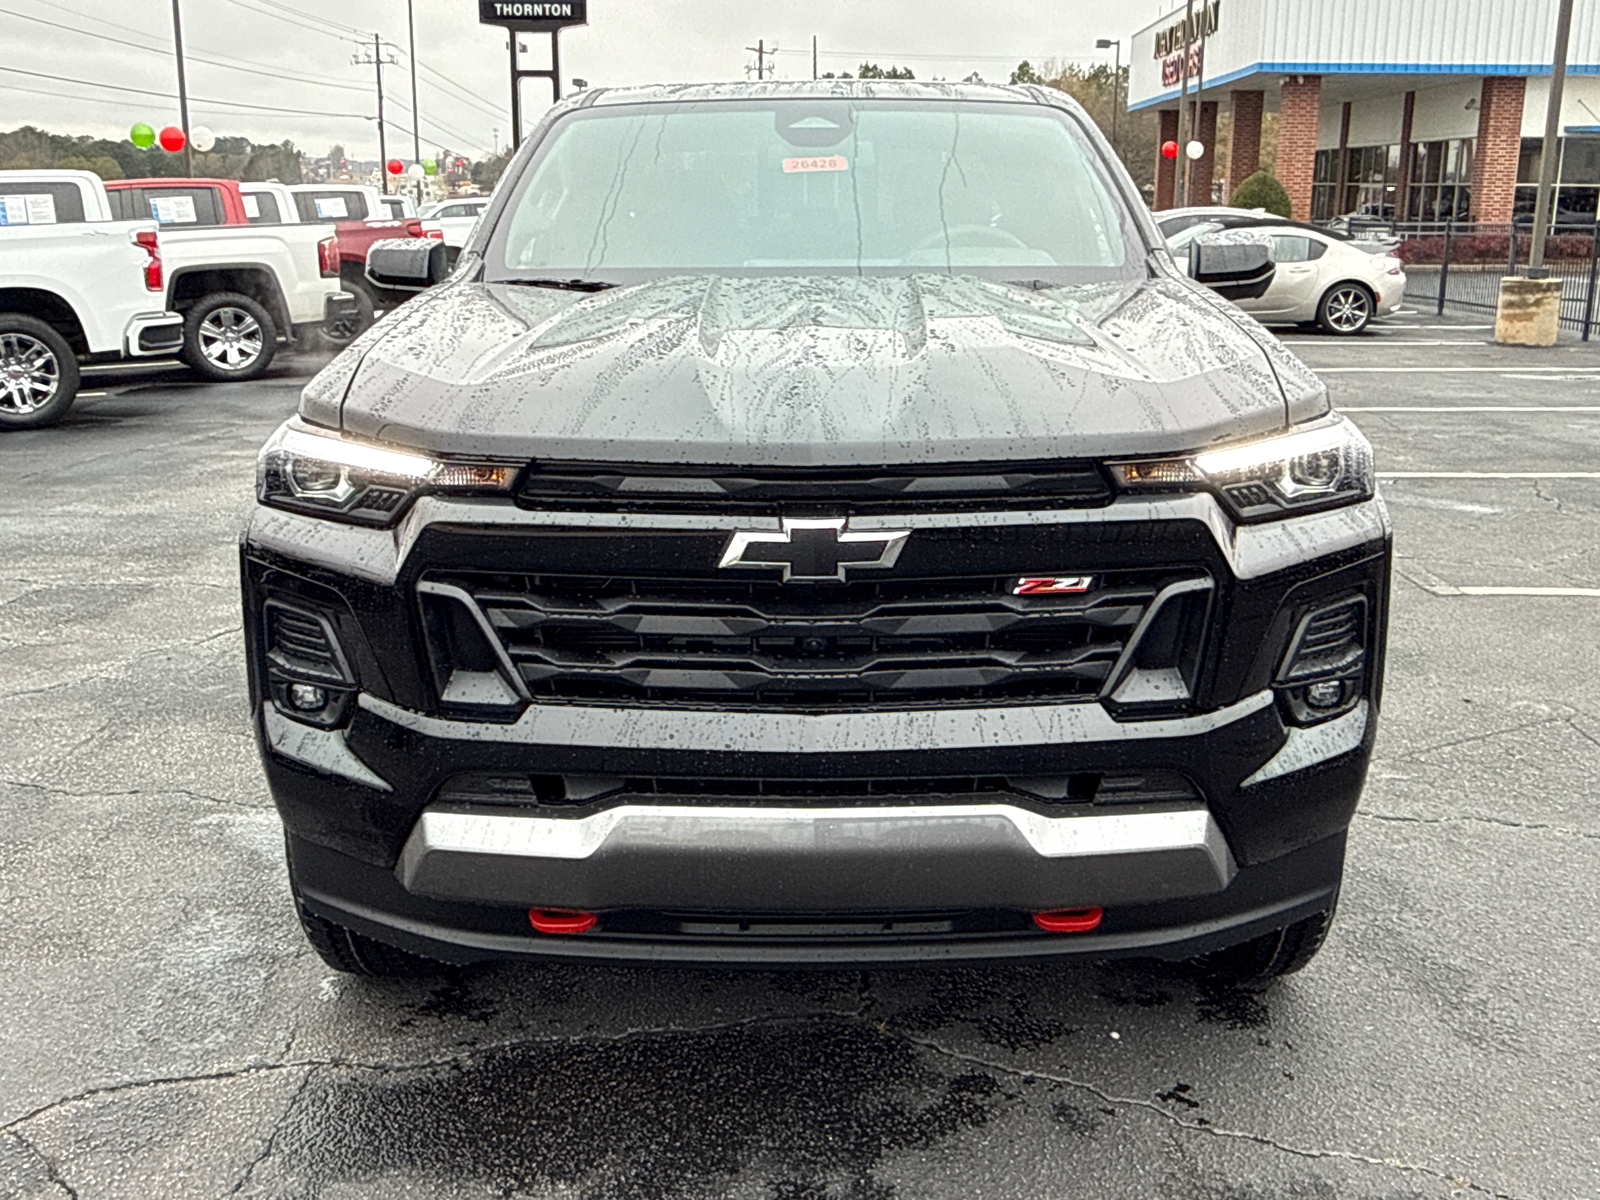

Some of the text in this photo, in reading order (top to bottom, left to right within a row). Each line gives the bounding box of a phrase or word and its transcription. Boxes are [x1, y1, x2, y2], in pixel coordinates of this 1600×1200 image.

[494, 3, 572, 16] THORNTON
[791, 159, 837, 169] 26428
[1012, 576, 1093, 595] Z71
